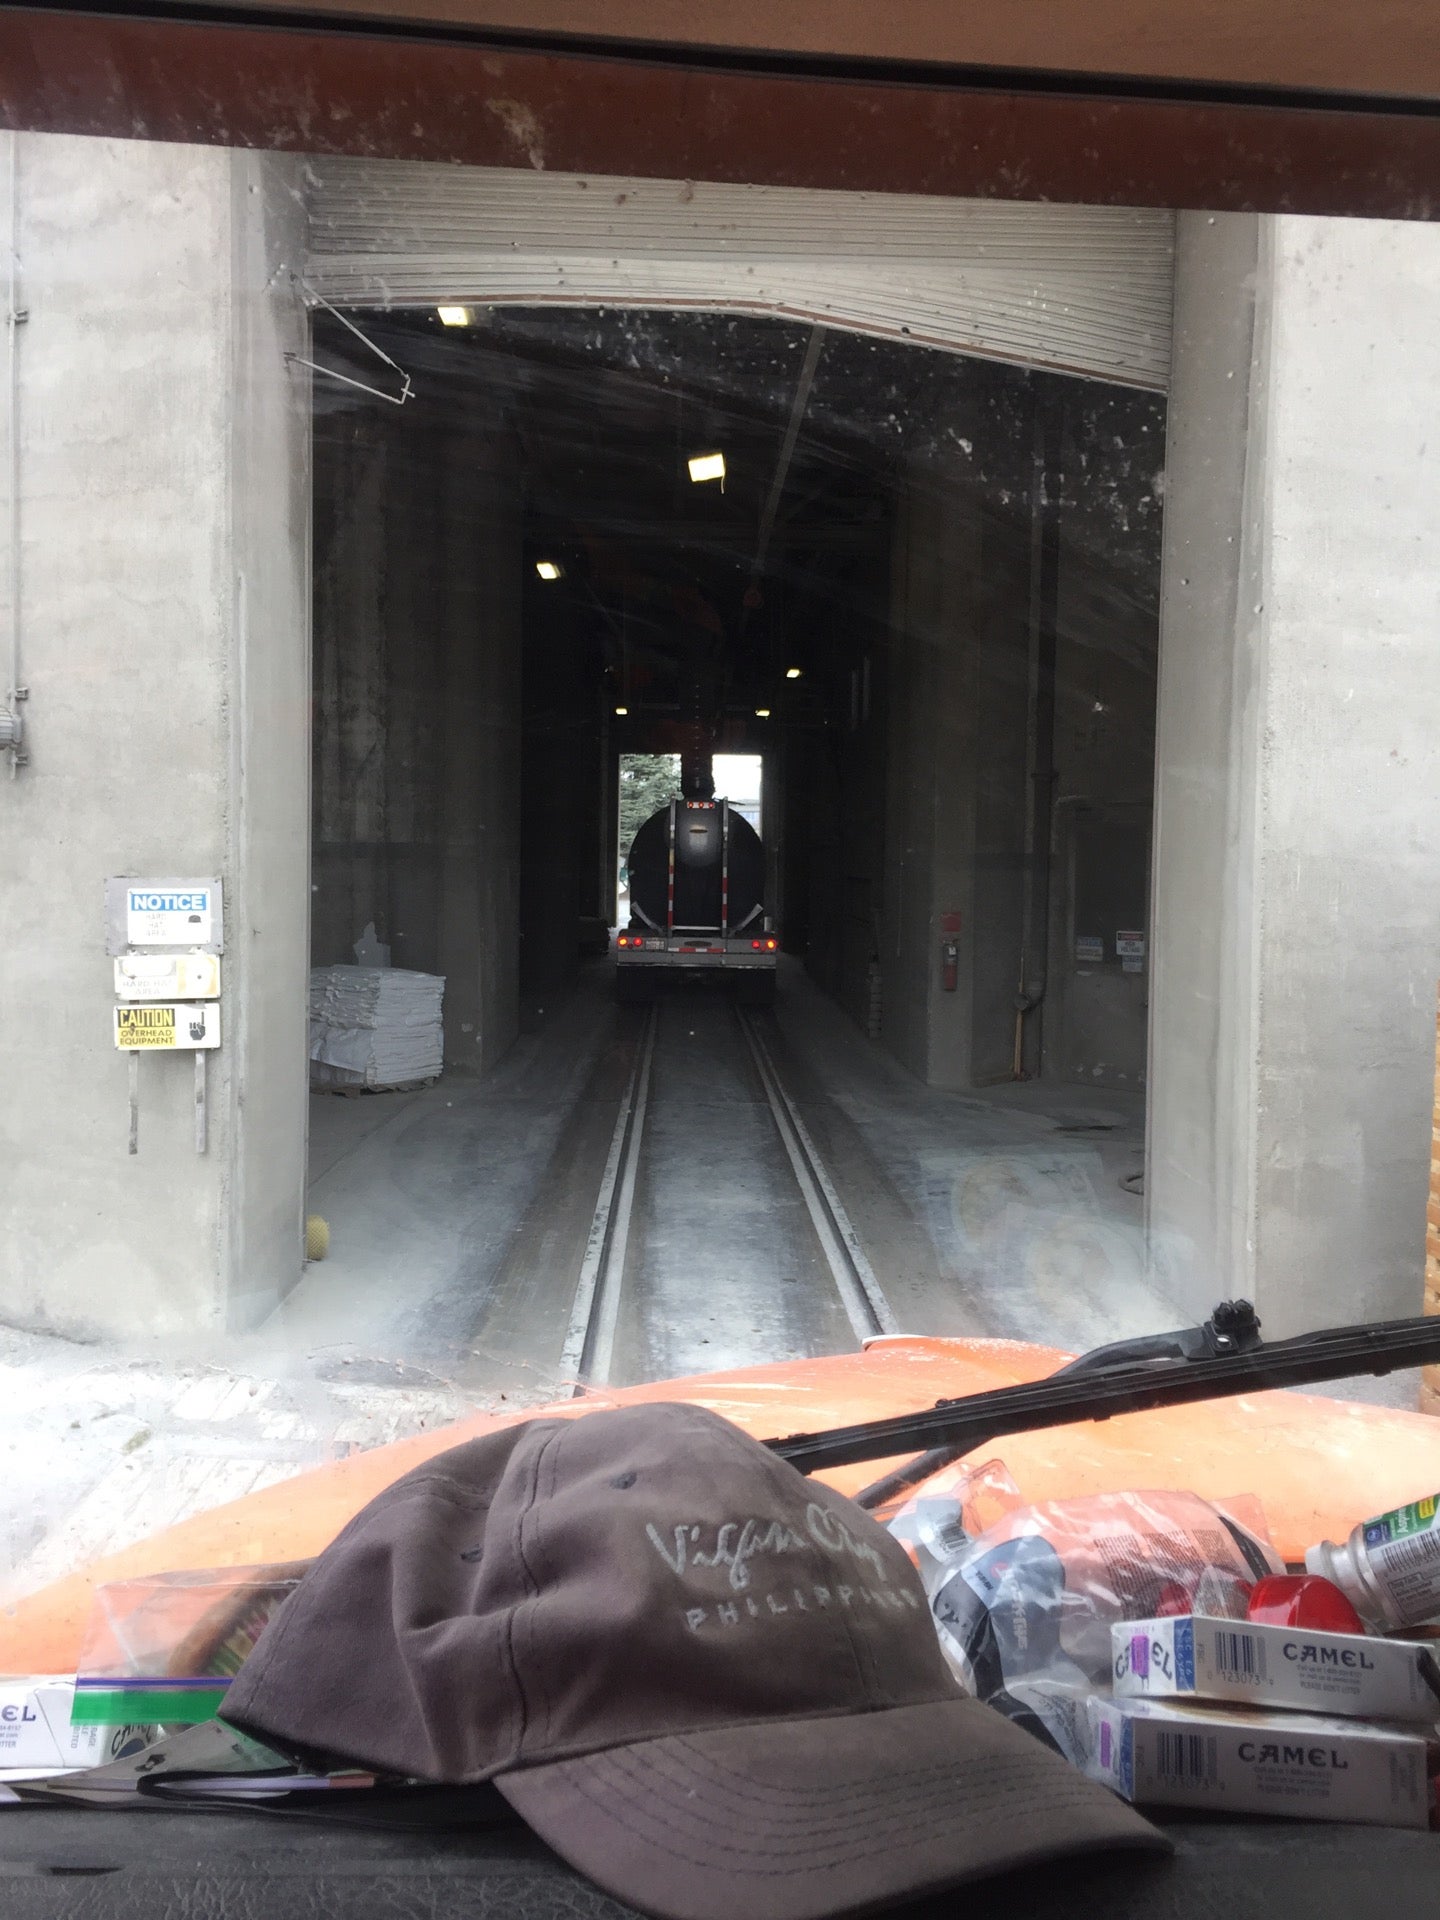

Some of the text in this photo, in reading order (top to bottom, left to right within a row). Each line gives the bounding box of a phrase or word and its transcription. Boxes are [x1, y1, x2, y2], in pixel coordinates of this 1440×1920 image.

[134, 895, 203, 910] NOTICE
[122, 979, 150, 987] HARD
[120, 1008, 173, 1027] CAUTION
[120, 1036, 174, 1045] EQUIPMENT
[121, 1029, 172, 1037] OVERHEAD
[1115, 1641, 1173, 1680] CAEL
[1283, 1642, 1374, 1670] CAMEL
[1222, 1671, 1261, 1686] 123073
[1238, 1742, 1348, 1770] CAMEL
